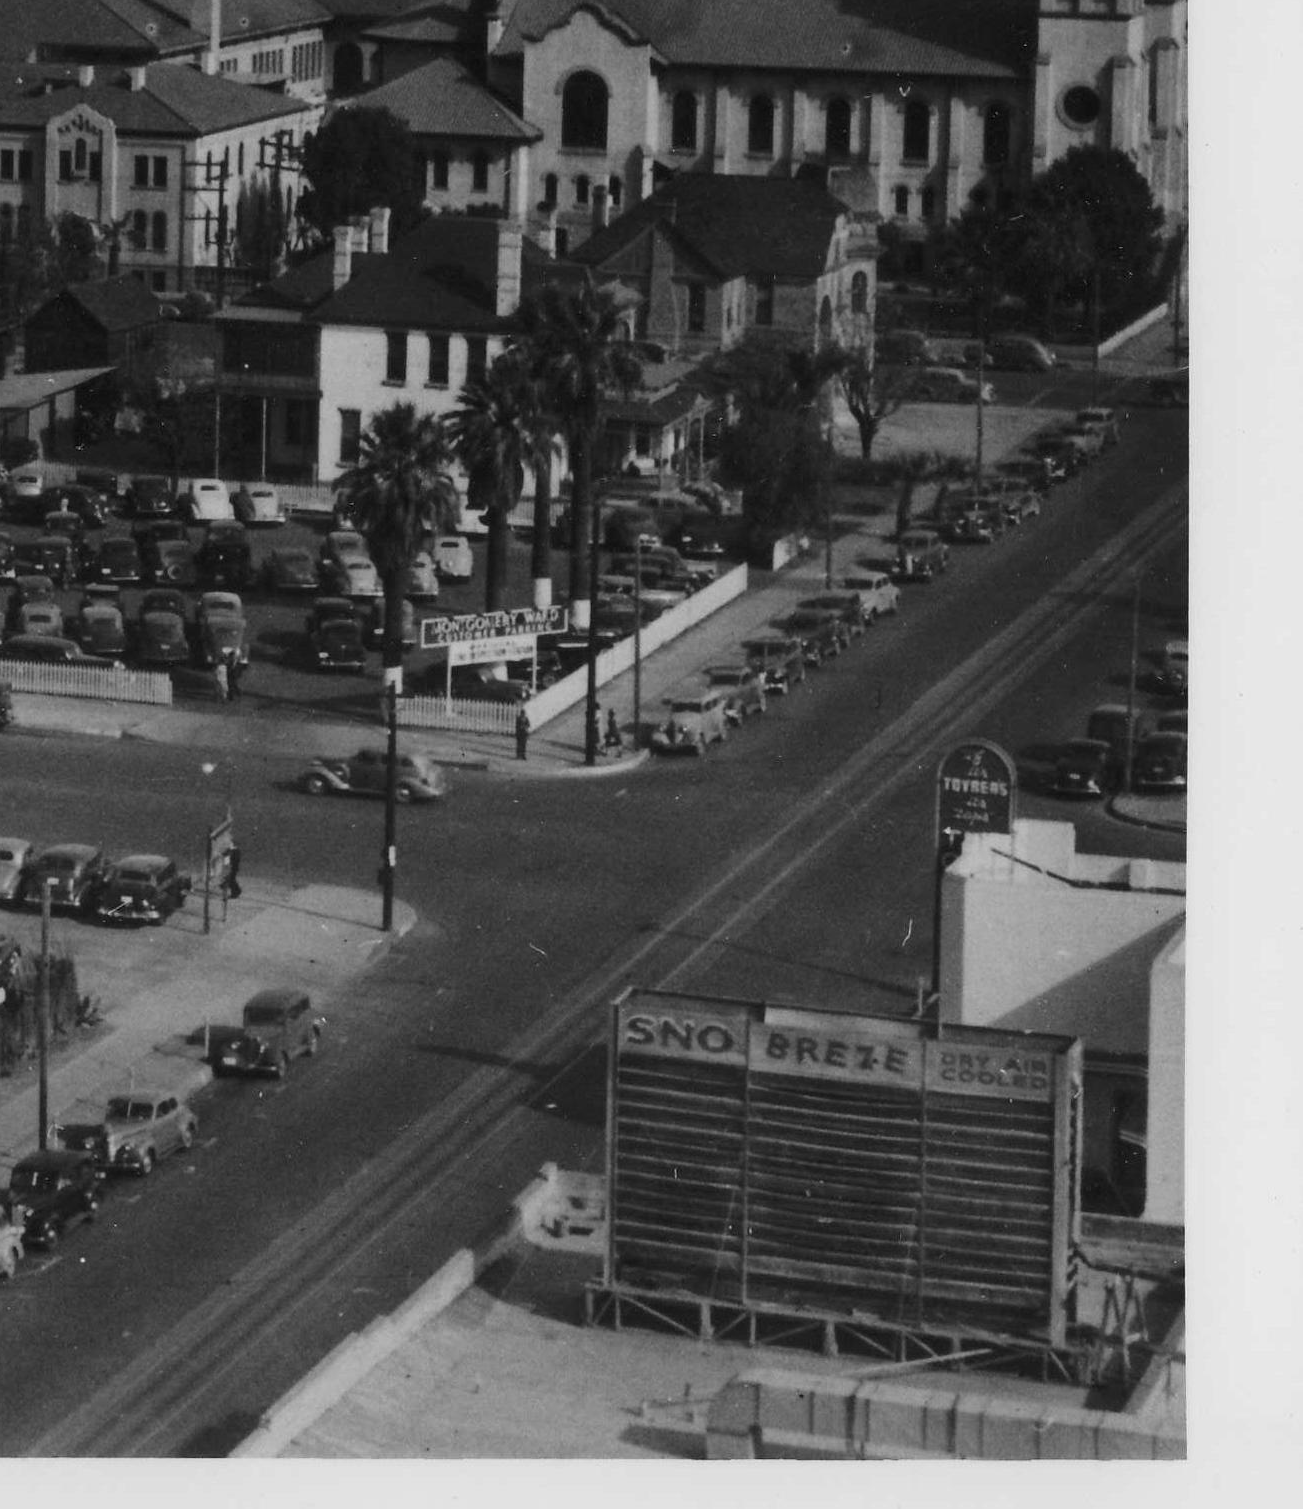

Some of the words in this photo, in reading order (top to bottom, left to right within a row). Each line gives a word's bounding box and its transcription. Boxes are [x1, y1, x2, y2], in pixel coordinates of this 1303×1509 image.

[625, 1013, 735, 1055] SNO
[940, 1051, 991, 1070] DRY
[1005, 1058, 1048, 1075] AIR
[940, 1069, 1049, 1090] COOLED
